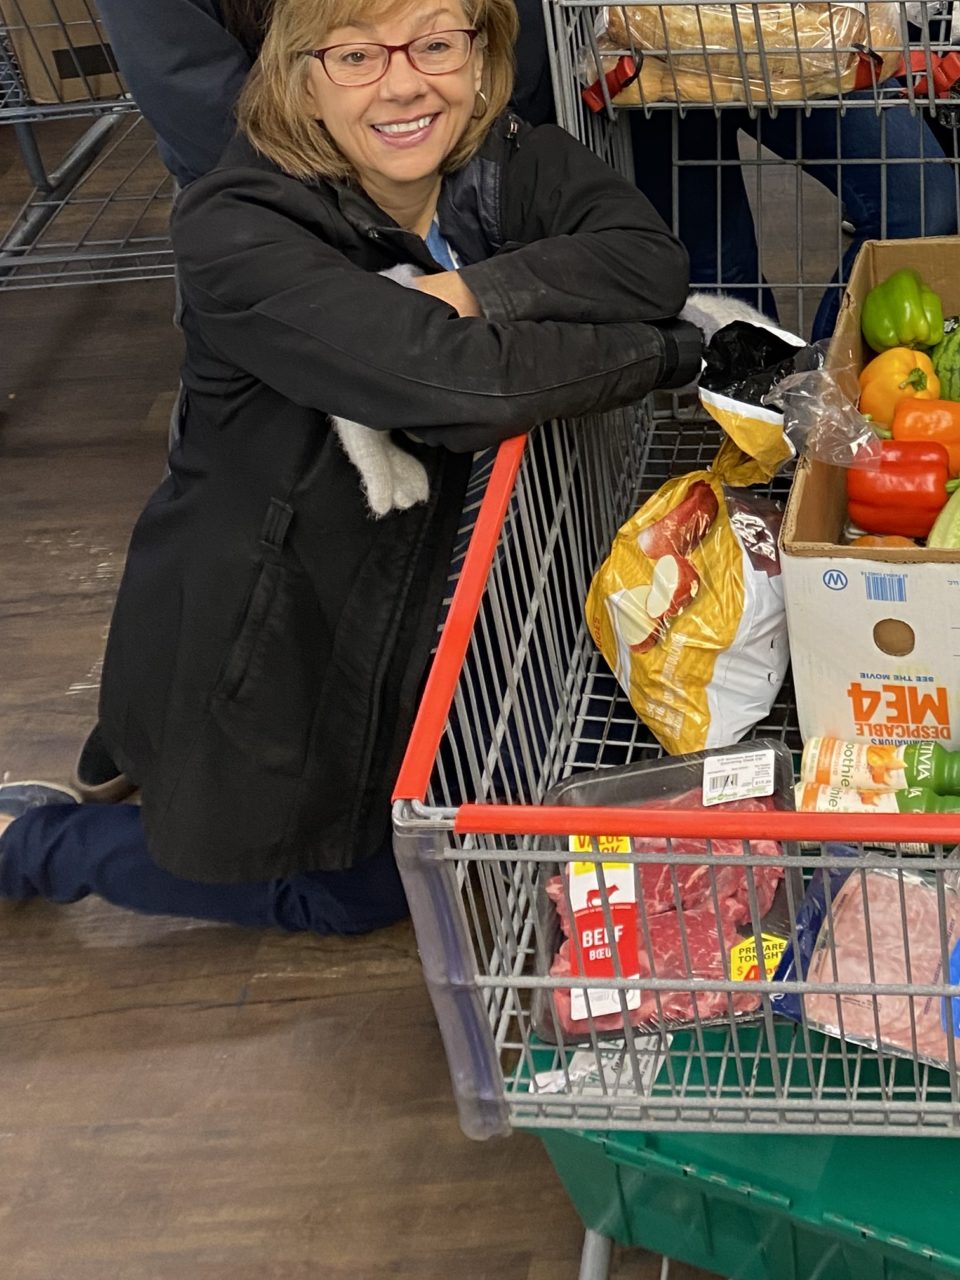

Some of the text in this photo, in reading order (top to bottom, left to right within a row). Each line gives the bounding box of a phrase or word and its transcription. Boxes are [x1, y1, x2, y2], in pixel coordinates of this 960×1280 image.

[859, 672, 891, 681] MOVIE
[854, 723, 951, 741] DESPICABLE
[841, 744, 855, 787] oothie
[917, 742, 934, 781] TIVIA
[589, 948, 613, 961] BŒU
[738, 942, 785, 956] PREARE
[738, 951, 784, 964] TONGHT
